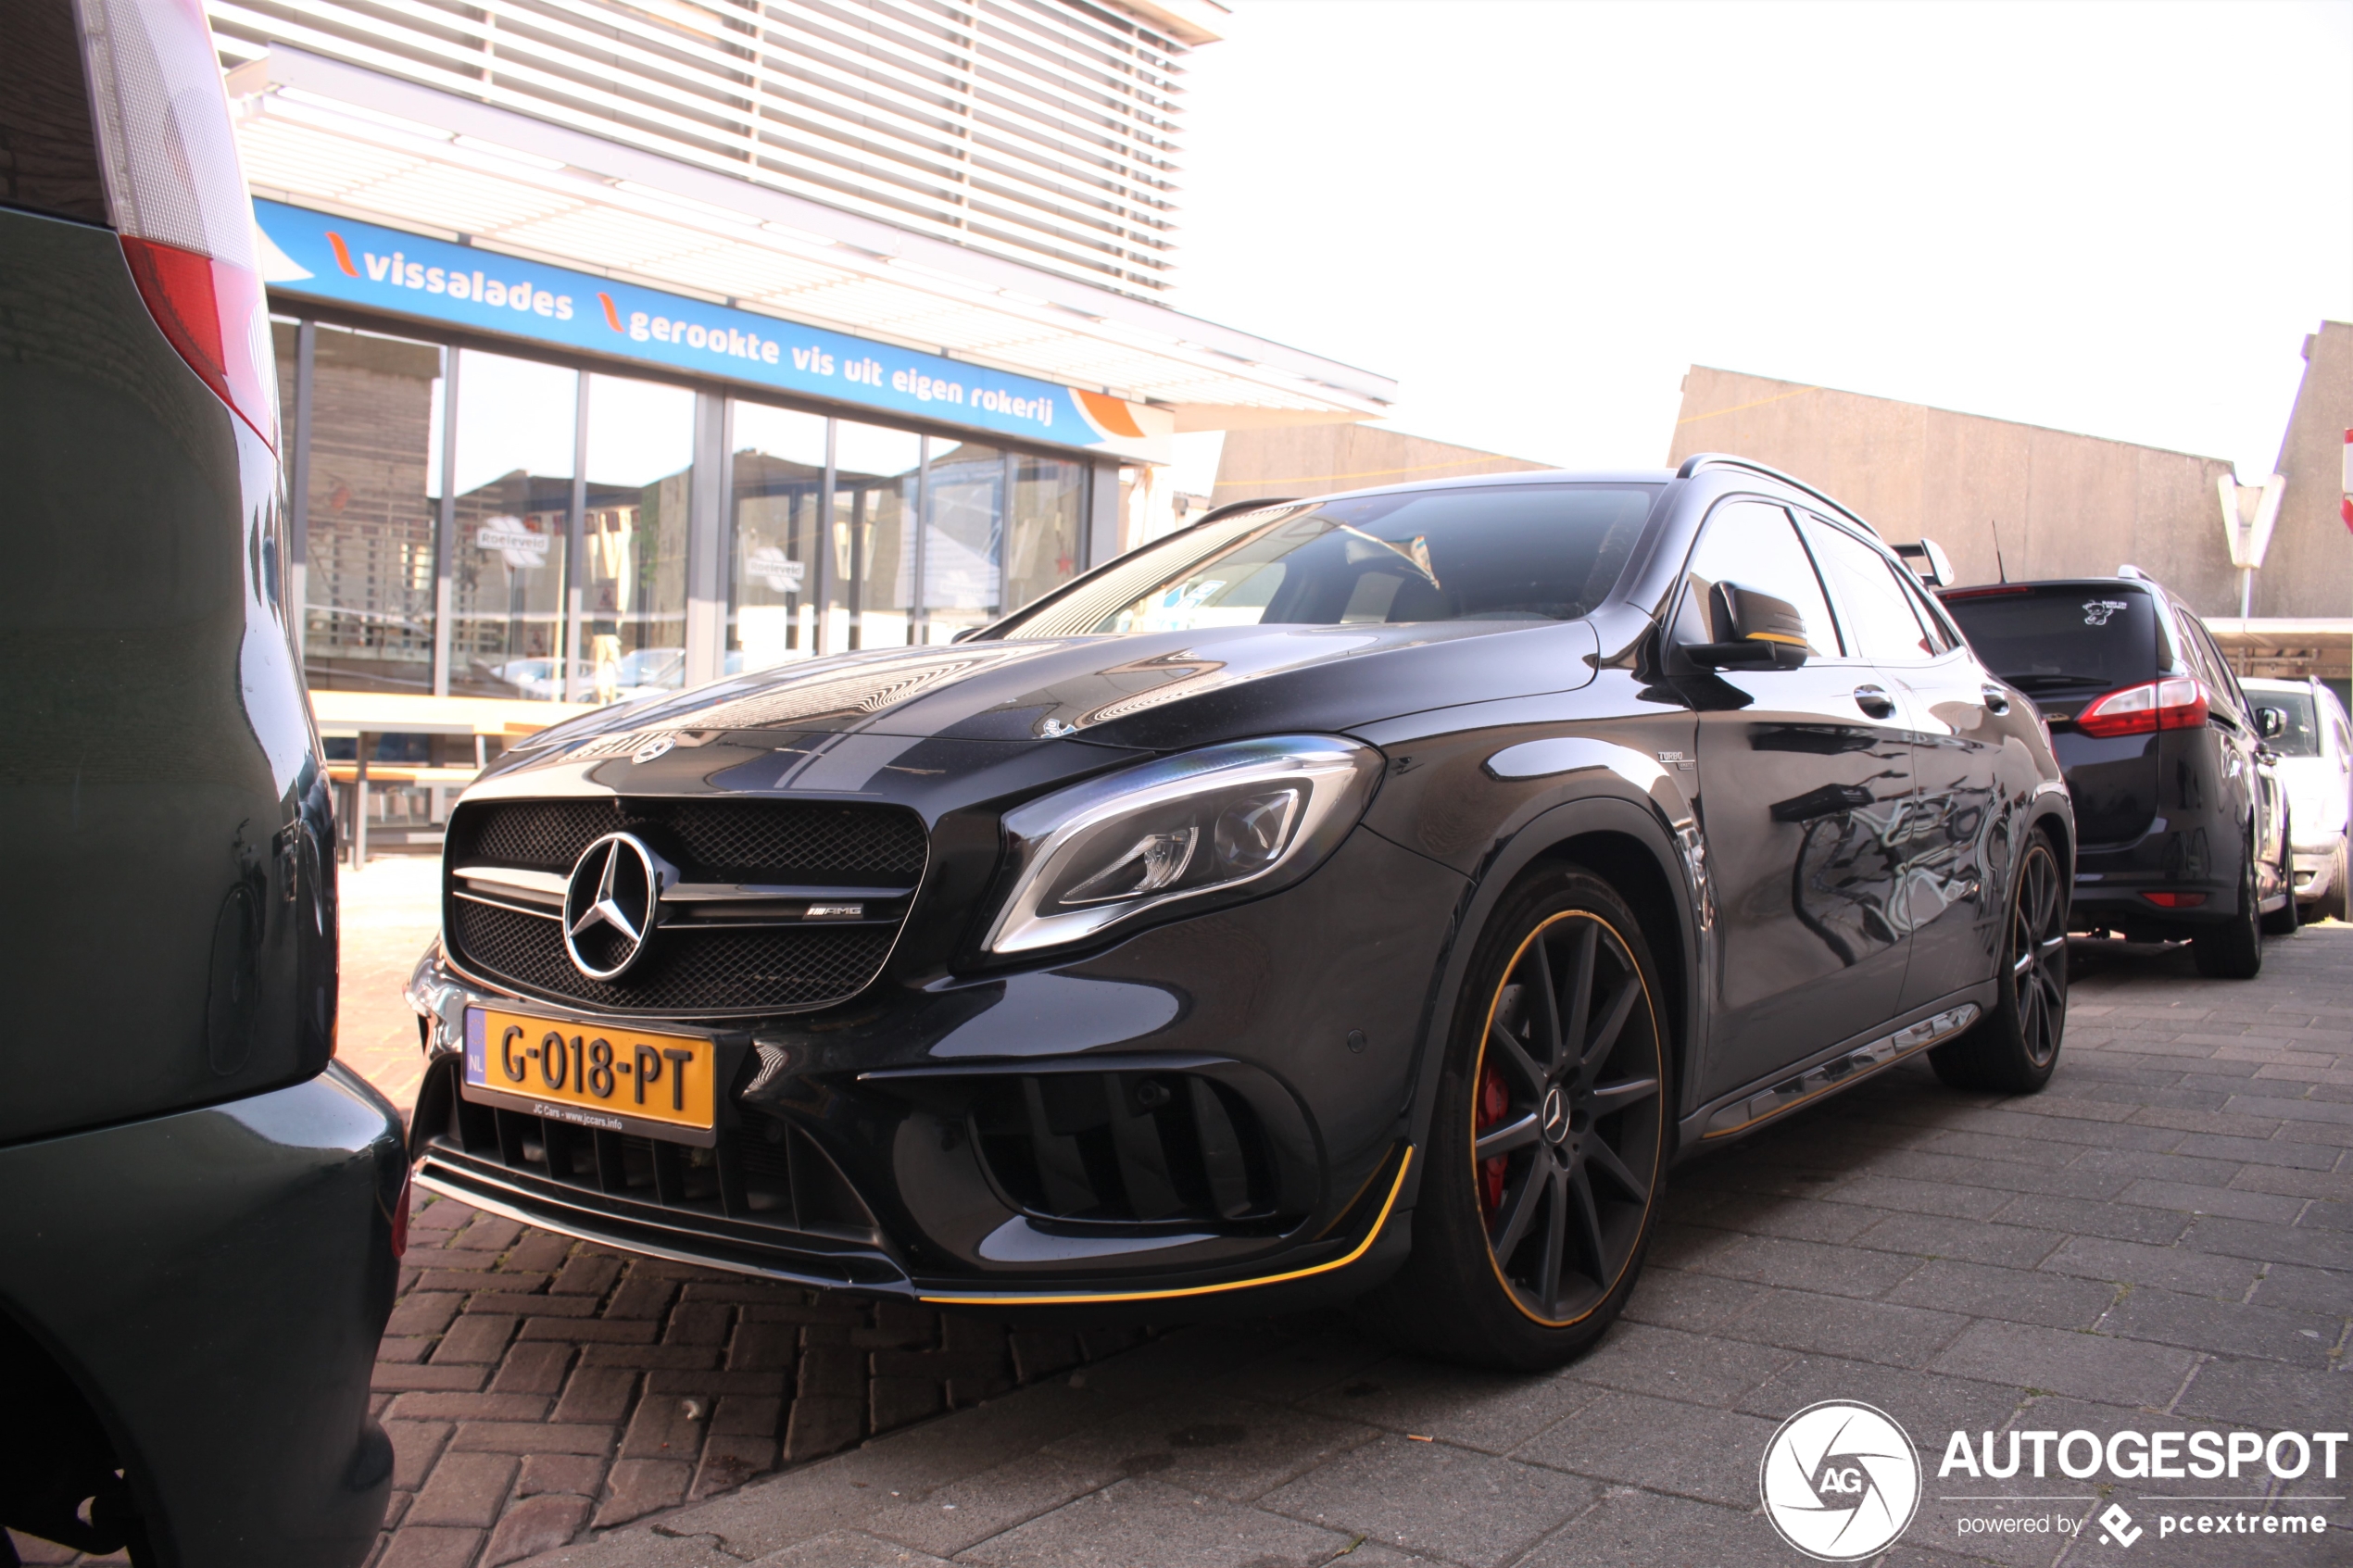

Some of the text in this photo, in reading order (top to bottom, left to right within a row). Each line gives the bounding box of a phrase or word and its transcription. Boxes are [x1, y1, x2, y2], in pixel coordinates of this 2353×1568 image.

[363, 252, 574, 320] vissalades
[629, 310, 1053, 426] gerookte vis uit eigen rokerij
[482, 533, 545, 548] Roeleveld
[1658, 751, 1682, 760] TURBO
[824, 907, 862, 915] AMG
[470, 1054, 484, 1073] NL
[501, 1025, 693, 1110] G-018-PT
[533, 1104, 543, 1114] JC
[544, 1106, 560, 1118] Cars
[565, 1111, 623, 1130] www.jccars.info
